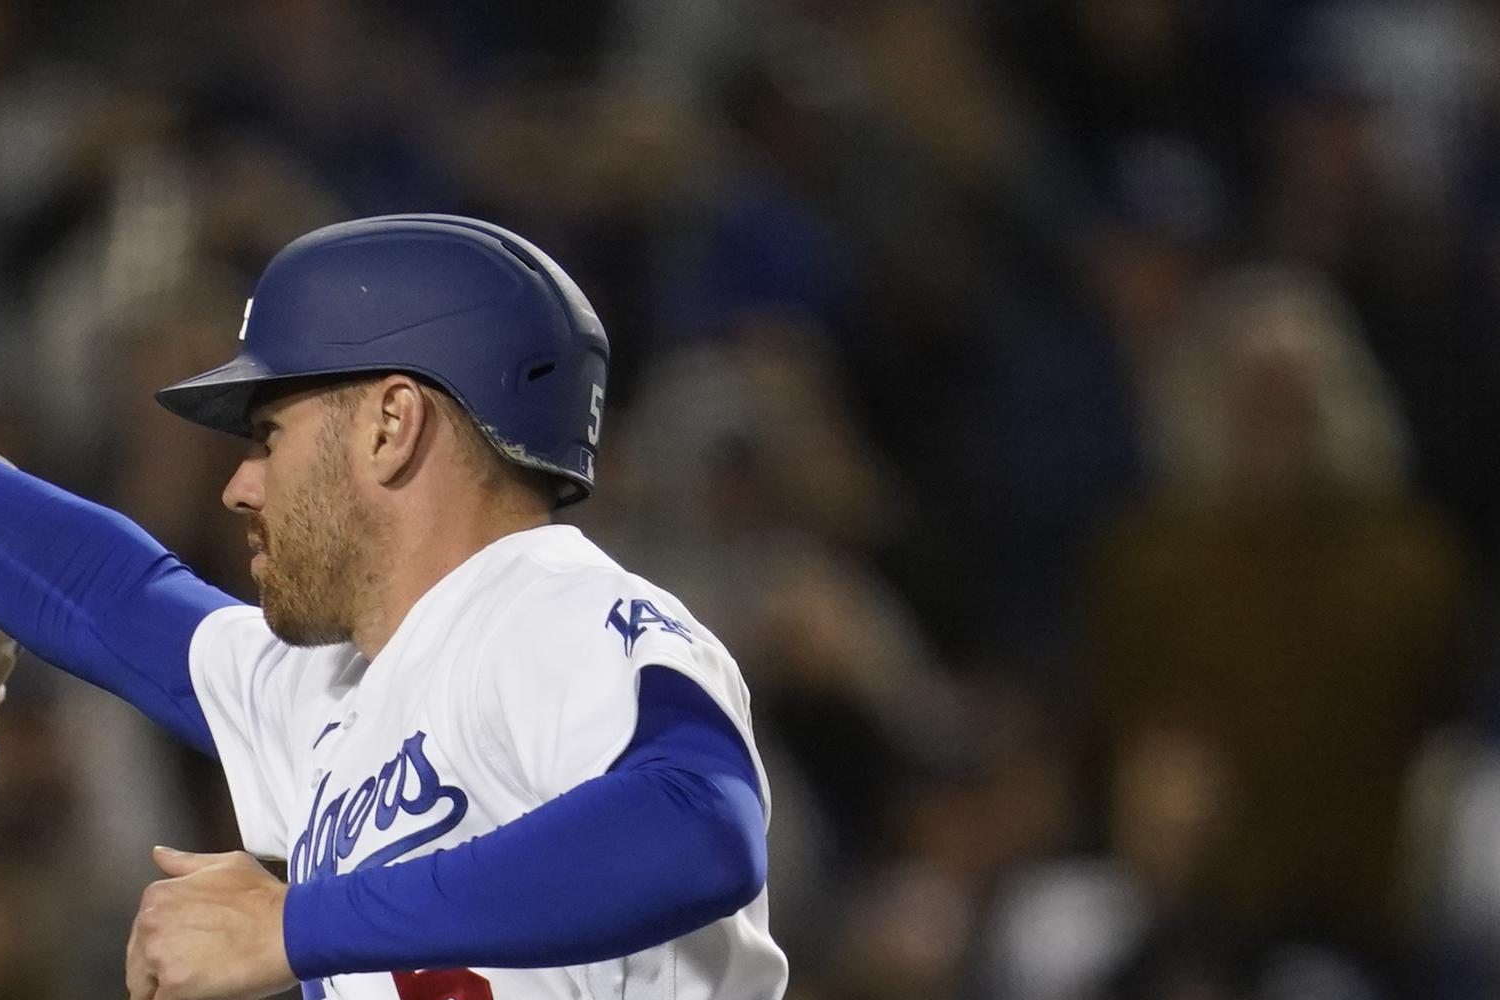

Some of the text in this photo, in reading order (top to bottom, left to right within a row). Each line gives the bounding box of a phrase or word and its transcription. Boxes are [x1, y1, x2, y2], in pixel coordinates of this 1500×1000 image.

[587, 383, 604, 446] 5
[605, 598, 692, 658] LA
[290, 730, 469, 884] dgers
